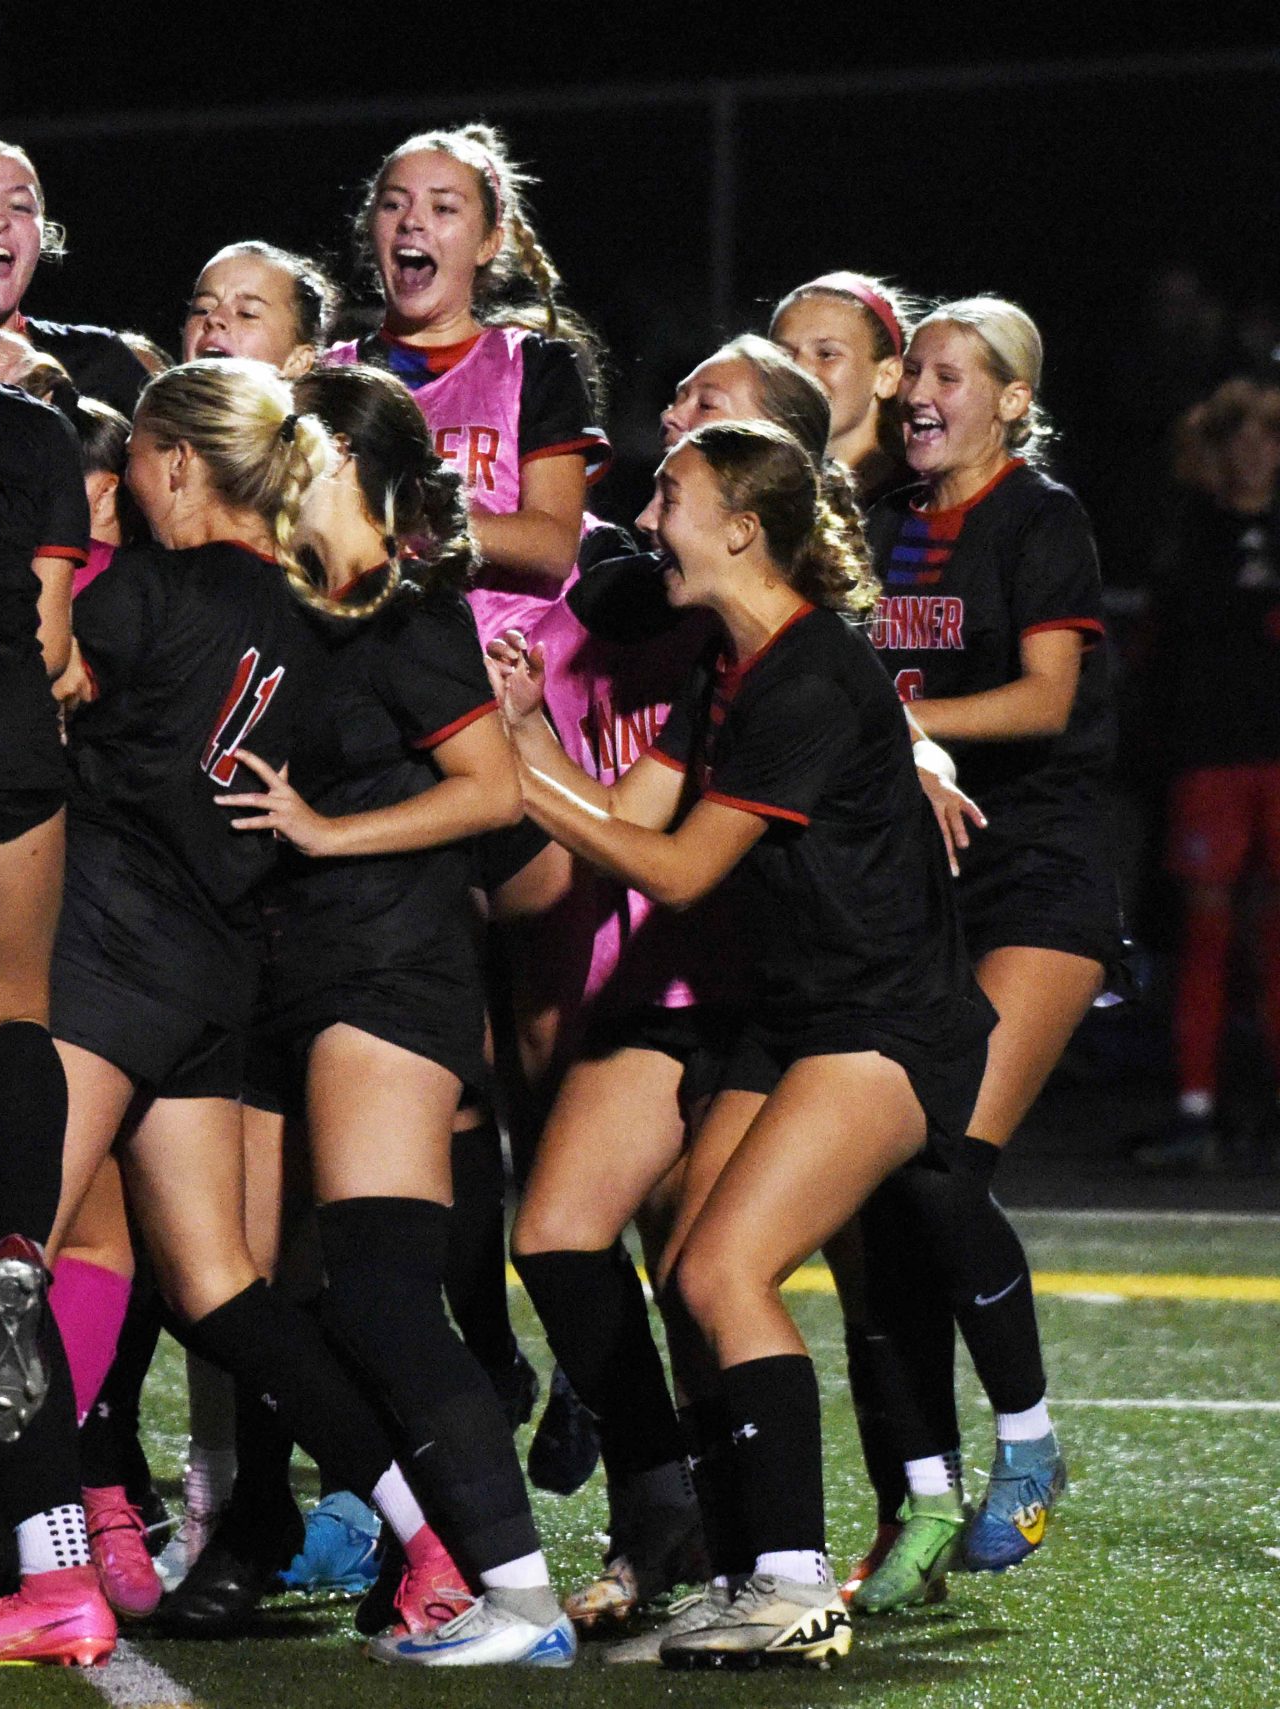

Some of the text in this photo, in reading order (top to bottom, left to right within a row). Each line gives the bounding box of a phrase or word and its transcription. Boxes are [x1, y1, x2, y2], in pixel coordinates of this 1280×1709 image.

[867, 595, 965, 650] ONNER
[200, 646, 286, 787] 11
[776, 1609, 853, 1648] AIR
